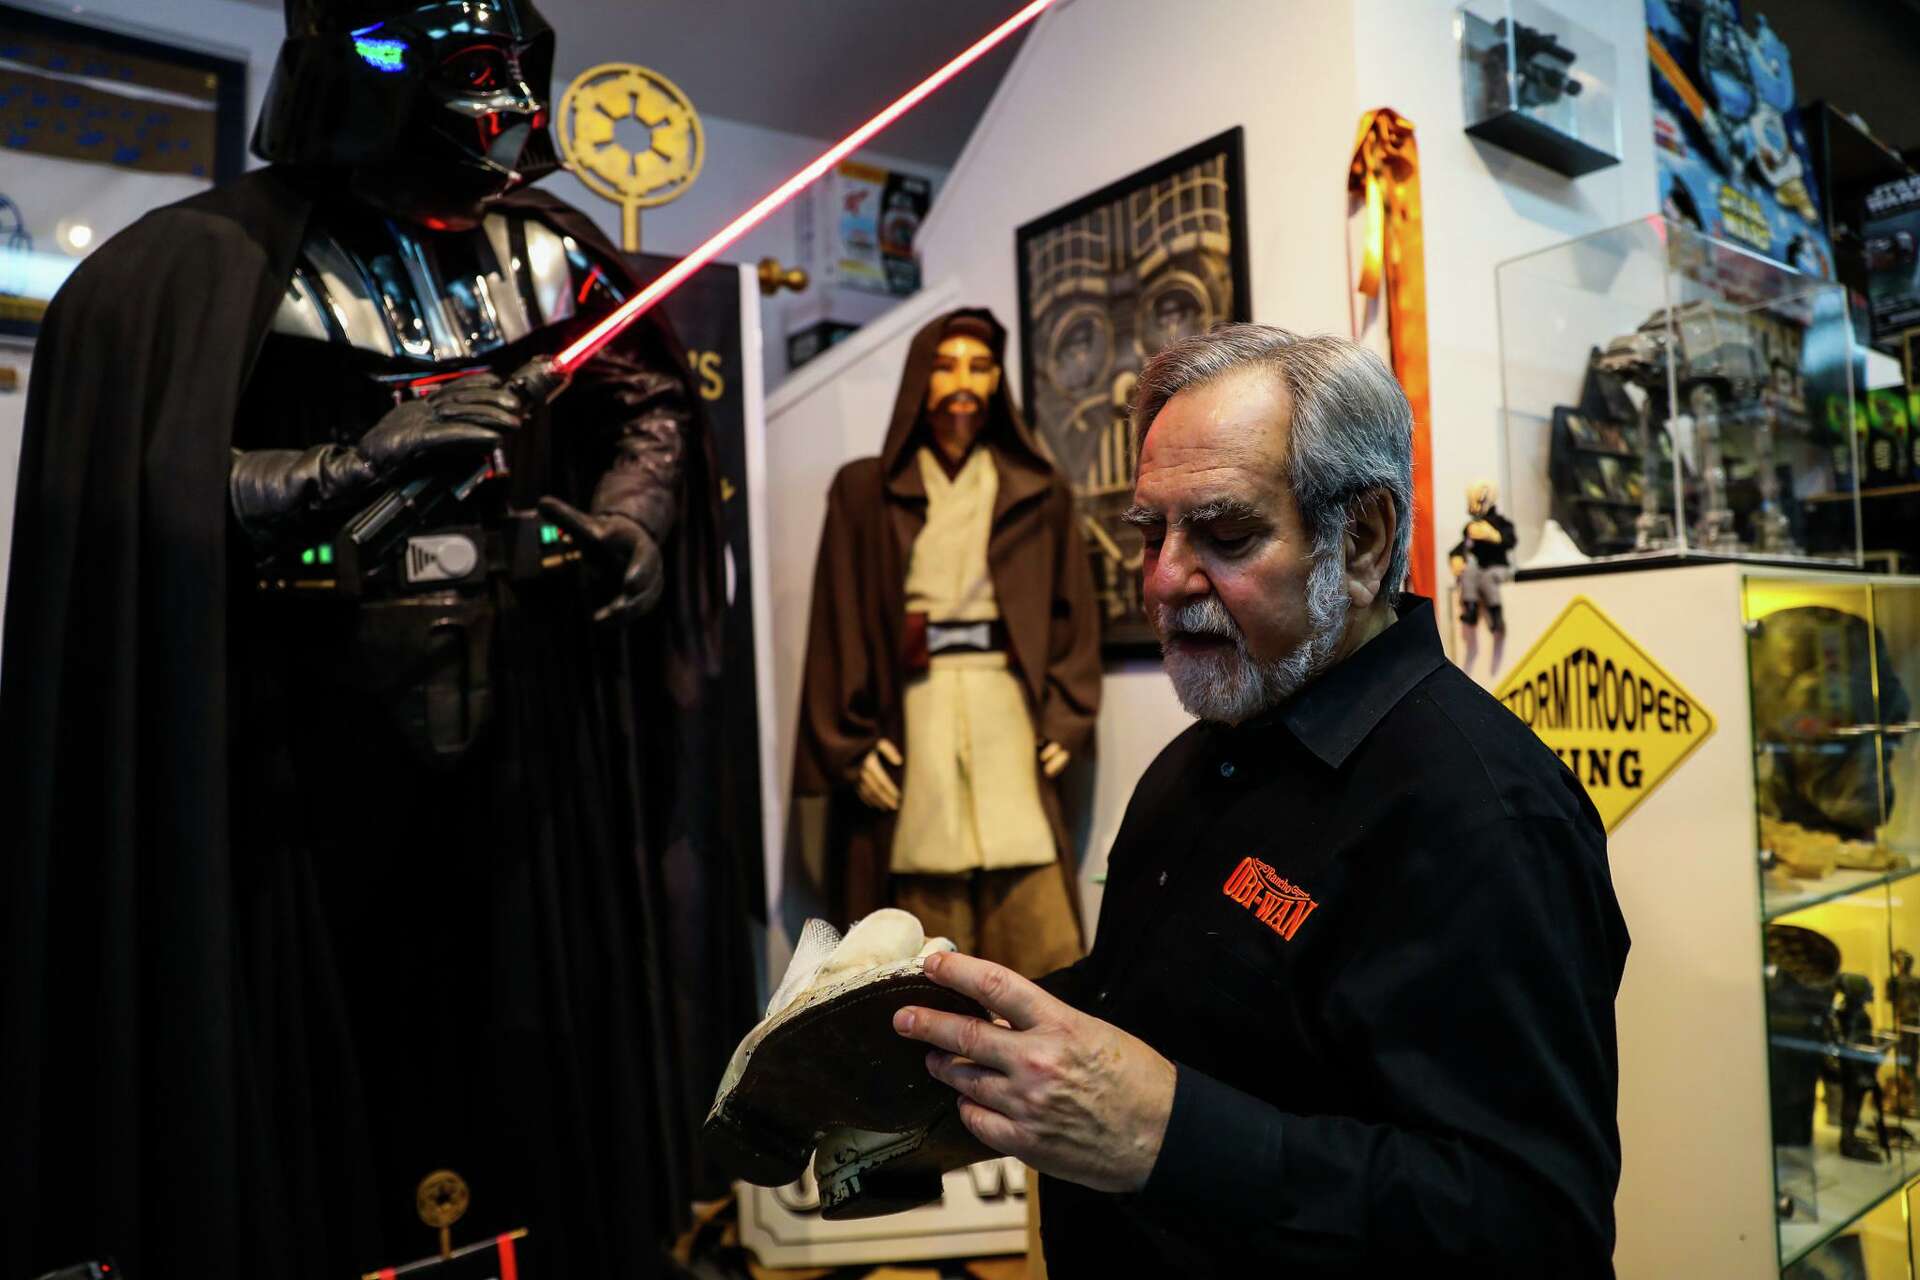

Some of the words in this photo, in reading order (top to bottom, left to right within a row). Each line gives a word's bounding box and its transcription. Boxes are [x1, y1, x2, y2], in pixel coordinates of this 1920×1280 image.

[1503, 648, 1692, 734] TORMTROOPER
[1556, 749, 1642, 788] ING
[1223, 856, 1319, 941] OBI-WAN
